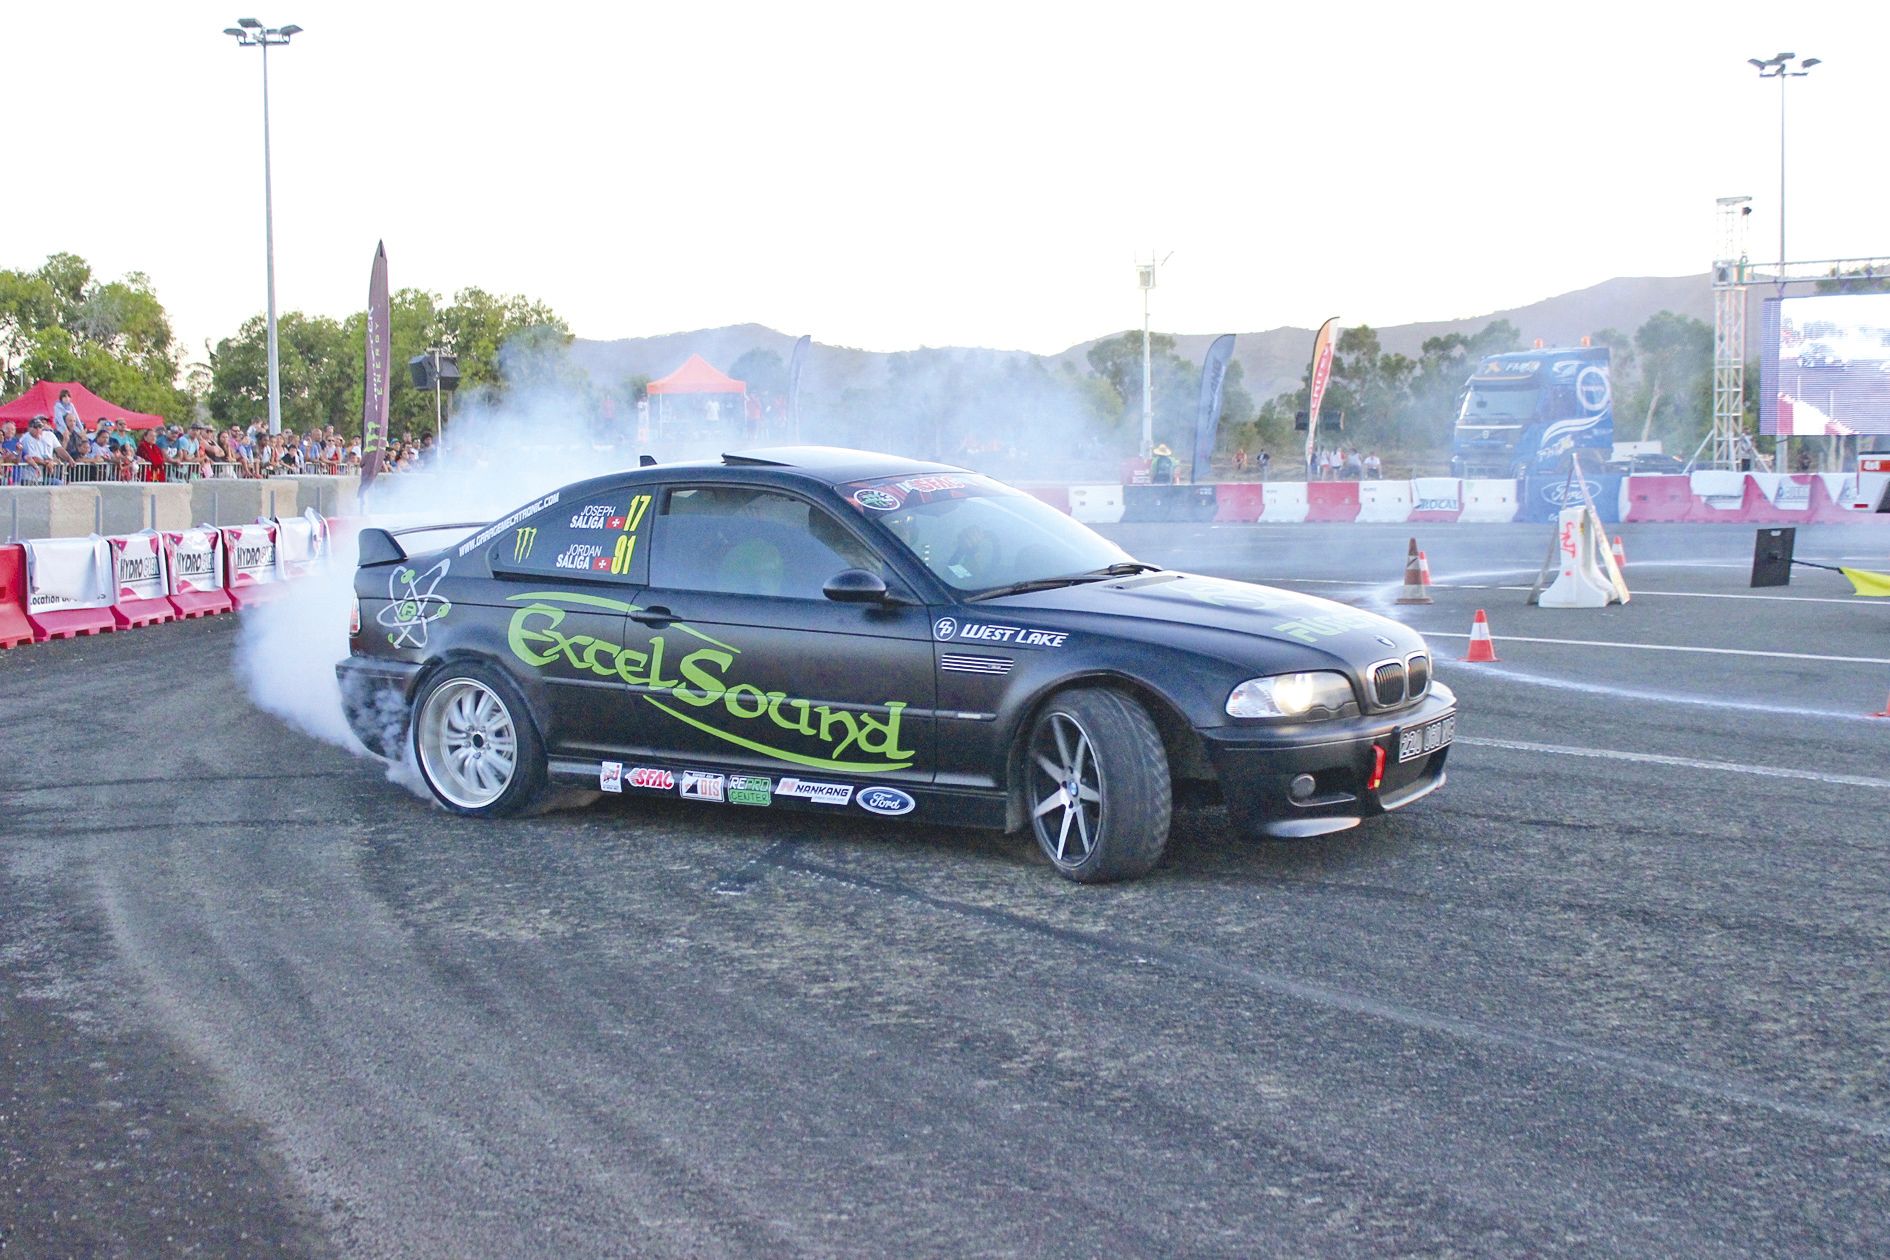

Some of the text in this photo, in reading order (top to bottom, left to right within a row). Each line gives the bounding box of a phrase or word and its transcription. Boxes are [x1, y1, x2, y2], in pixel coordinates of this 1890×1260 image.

[580, 505, 616, 517] JOSEPH
[622, 495, 652, 532] 17
[569, 515, 605, 530] SALIGA
[566, 544, 602, 557] JORDAN
[610, 534, 638, 575] 91
[555, 555, 590, 570] SALIGA
[960, 624, 1019, 643] WEST
[1014, 629, 1069, 648] LAKE
[635, 769, 674, 788] SFAC
[730, 777, 770, 792] REPRO
[730, 790, 769, 804] CENTER
[795, 784, 849, 797] NANKANG
[869, 792, 900, 810] Ford
